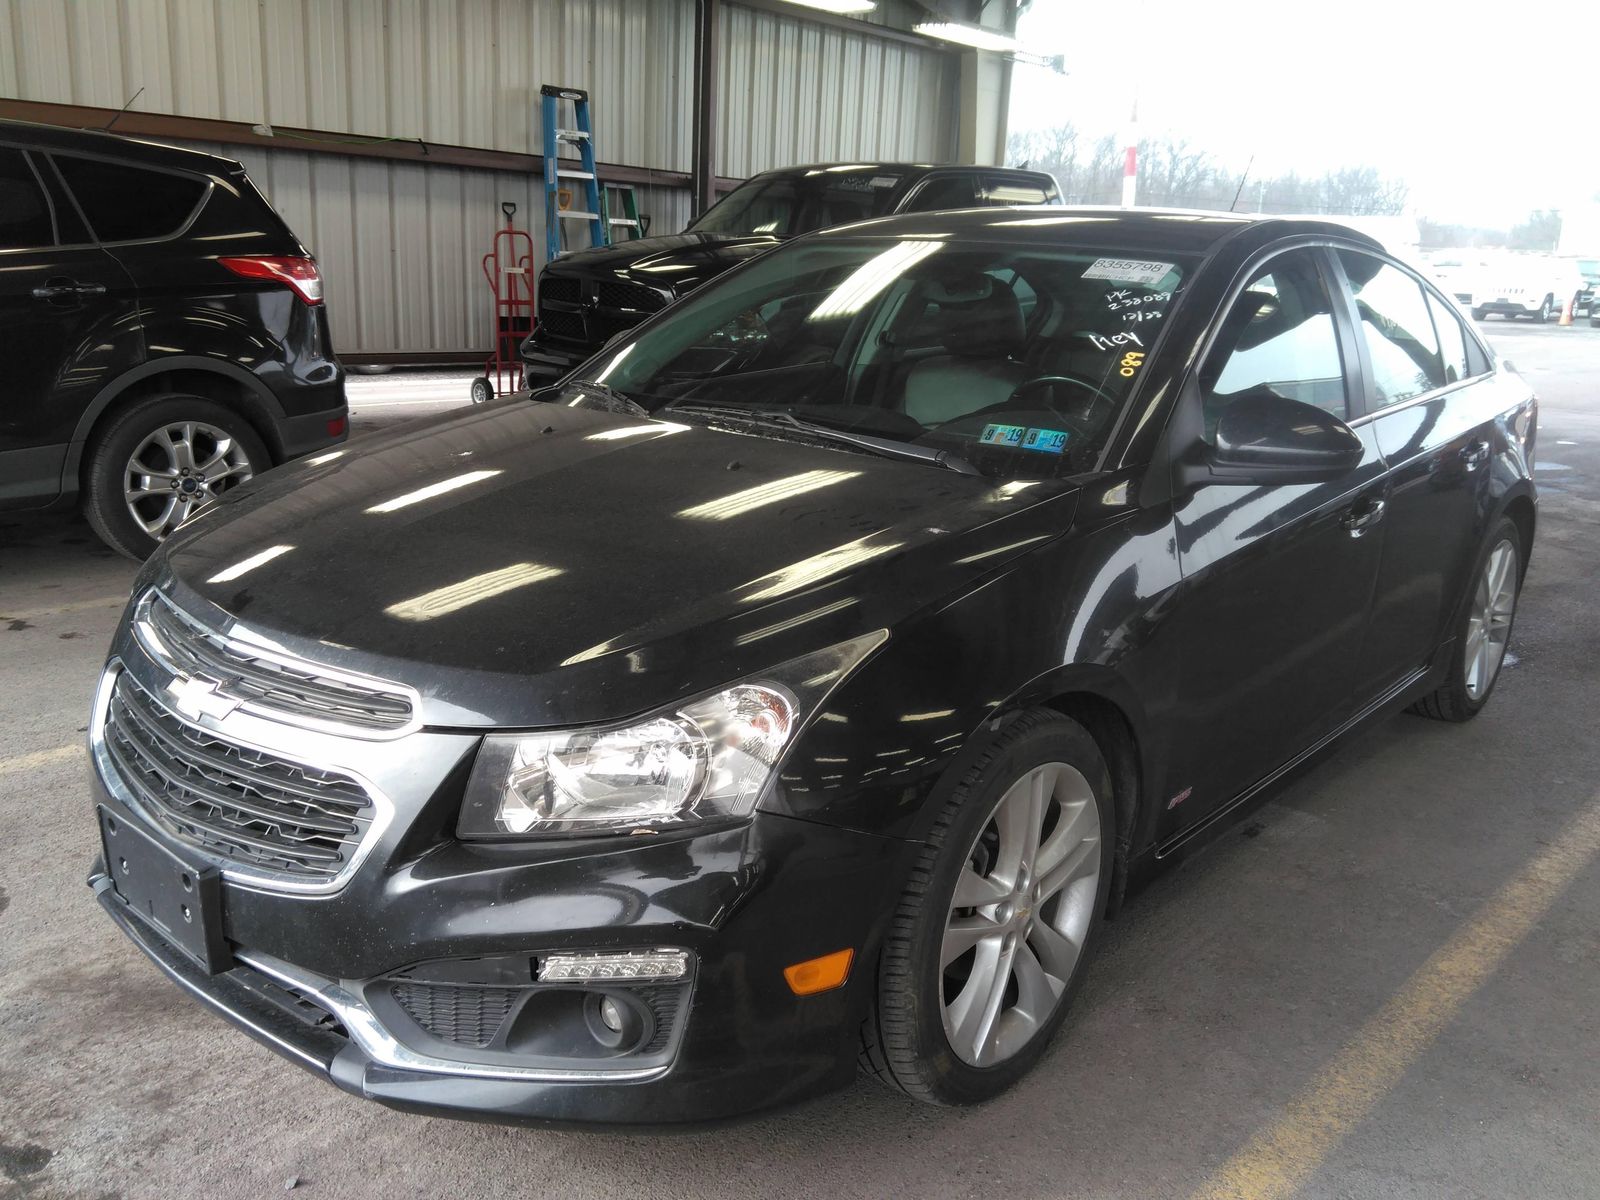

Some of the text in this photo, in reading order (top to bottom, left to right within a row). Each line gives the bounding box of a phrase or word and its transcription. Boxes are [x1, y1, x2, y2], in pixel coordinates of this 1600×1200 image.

[1093, 259, 1163, 273] 8355798
[1120, 351, 1145, 377] 089
[985, 428, 1023, 442] 9 19
[1028, 433, 1066, 448] 9 19
